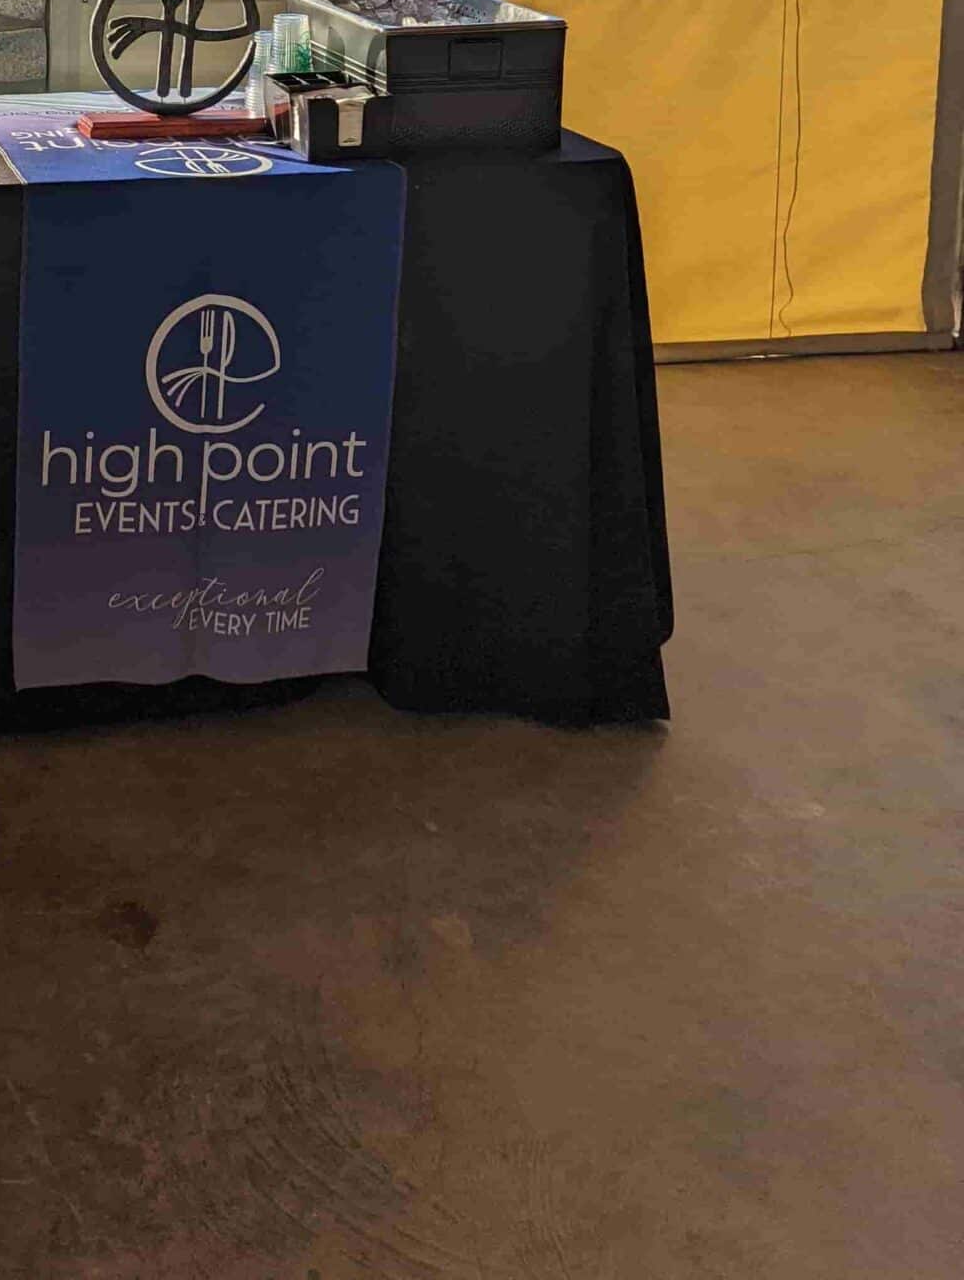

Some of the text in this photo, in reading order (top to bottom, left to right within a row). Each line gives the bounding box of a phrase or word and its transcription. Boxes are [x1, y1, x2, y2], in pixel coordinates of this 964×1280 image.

[41, 427, 367, 514] high point
[75, 500, 196, 534] EVENTS
[213, 494, 360, 531] CATERING
[108, 567, 325, 629] exceptional
[188, 606, 312, 635] EVERY TIME
